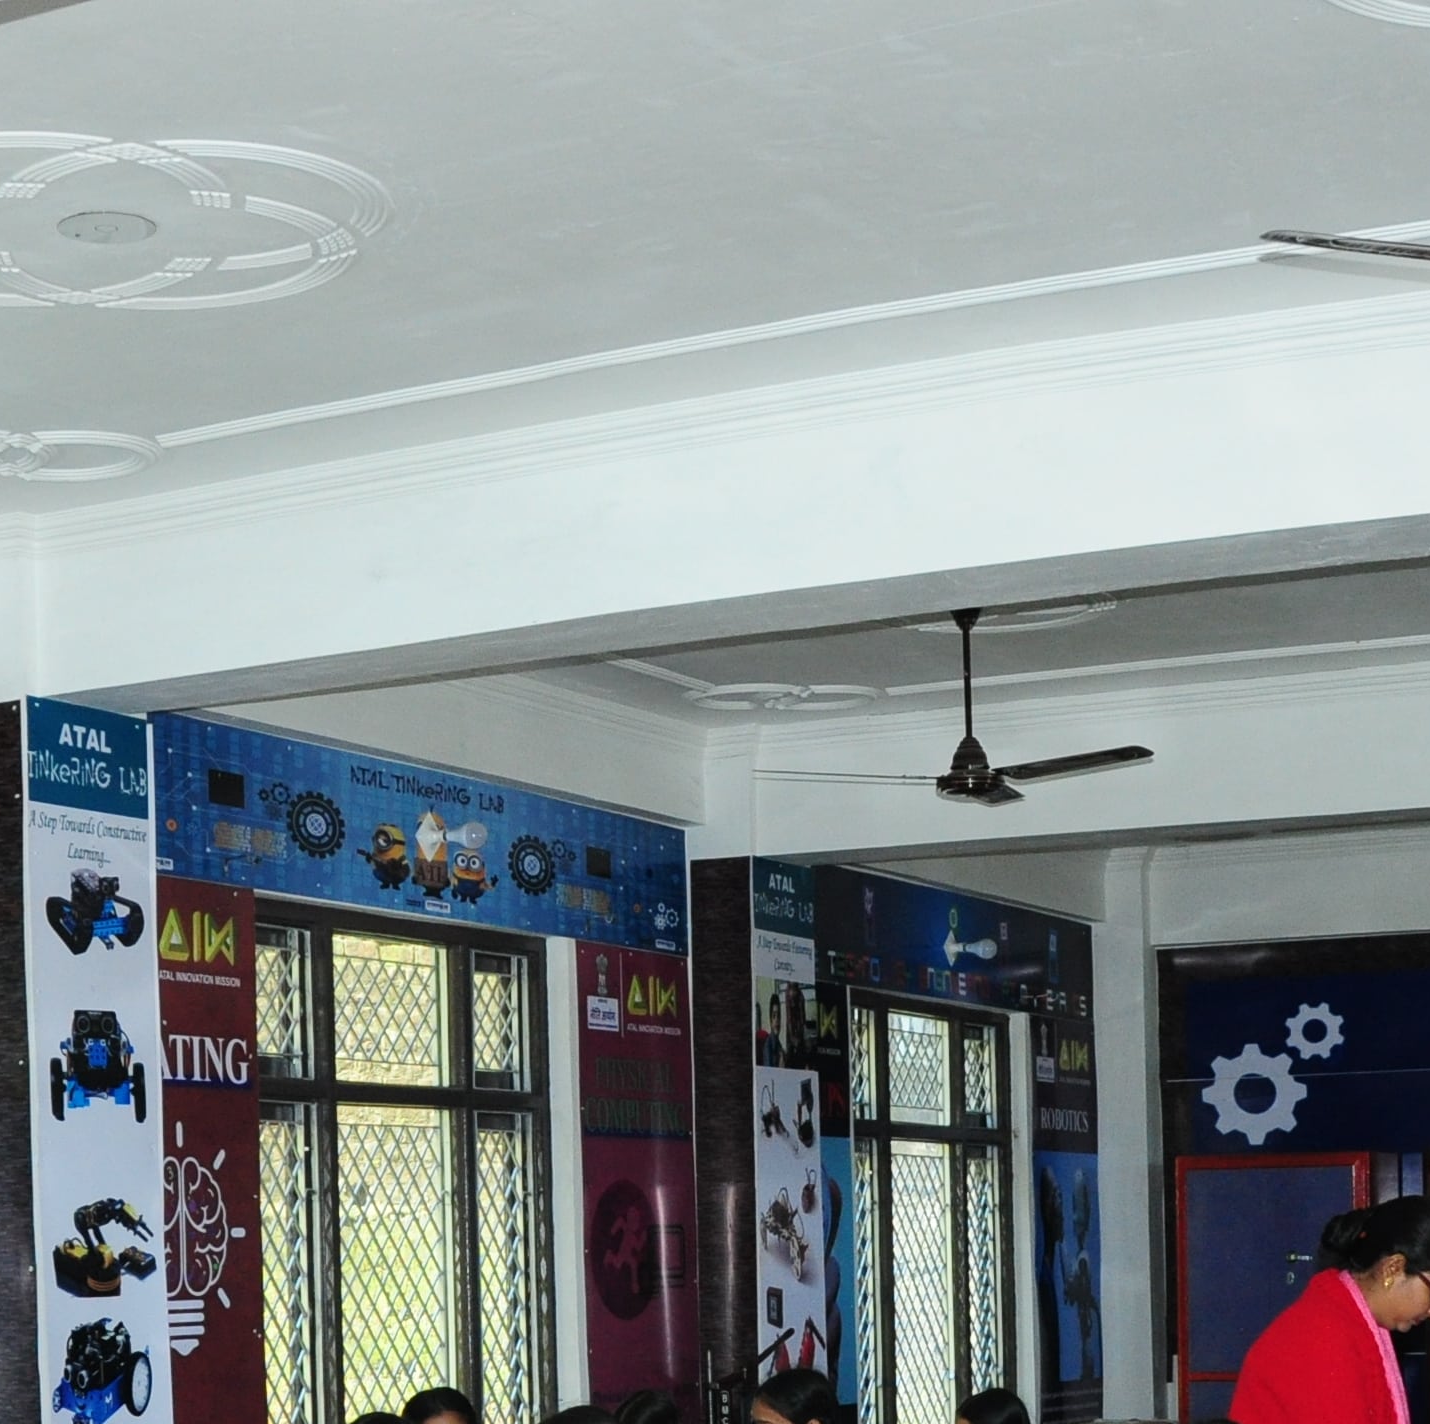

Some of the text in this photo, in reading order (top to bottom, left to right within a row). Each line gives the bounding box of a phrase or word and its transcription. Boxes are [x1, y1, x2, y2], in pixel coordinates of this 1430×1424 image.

[58, 722, 112, 754] ATAL
[119, 766, 147, 797] LAB
[479, 793, 505, 814] LAB
[768, 872, 796, 894] ATAL
[175, 971, 214, 985] INNOVATION
[214, 975, 241, 988] MISSION
[1040, 1107, 1090, 1133] ROBOTICS
